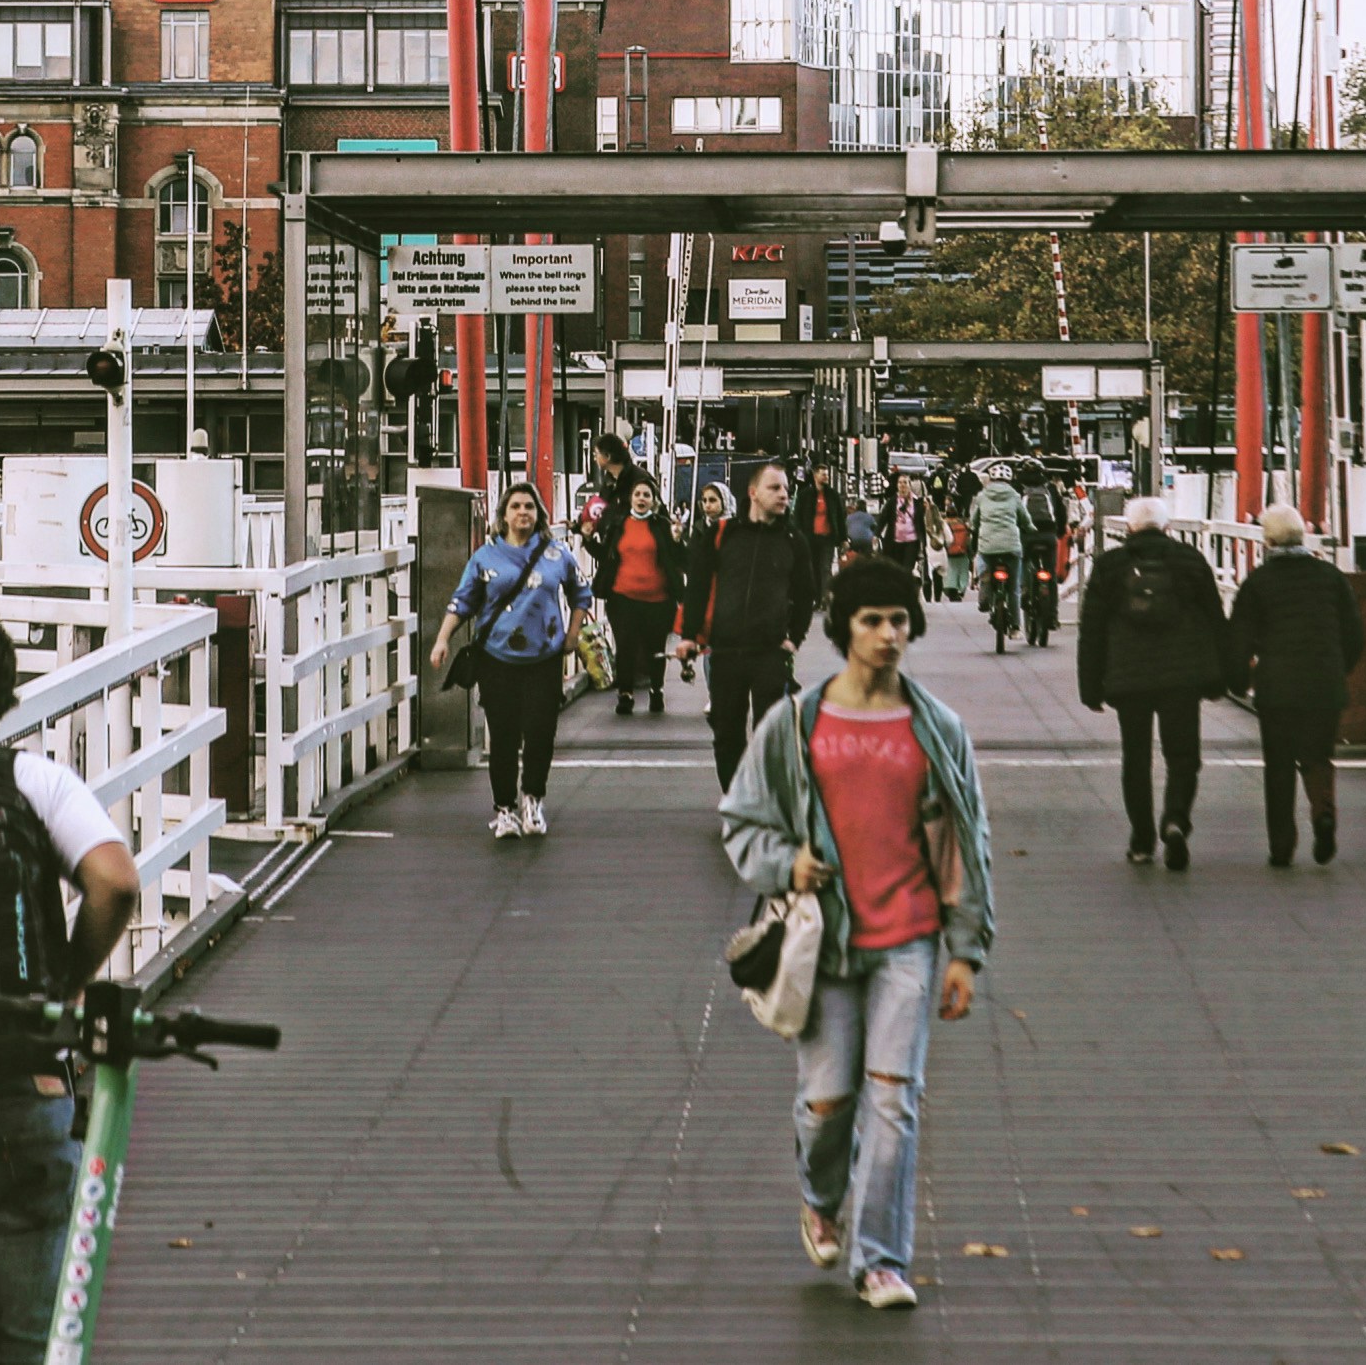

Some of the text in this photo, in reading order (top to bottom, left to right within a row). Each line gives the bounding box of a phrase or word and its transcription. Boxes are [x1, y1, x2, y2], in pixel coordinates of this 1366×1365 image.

[732, 244, 785, 262] KFC
[412, 250, 465, 267] Achtung
[512, 253, 573, 266] Important
[392, 270, 485, 282] Bei Ertönen des Signals
[499, 271, 586, 281] When the bell rings
[397, 284, 480, 294] bitte an die Haltelinie
[505, 284, 581, 294] please step back
[412, 297, 465, 307] zurücktreten
[510, 298, 576, 306] behind the line
[732, 296, 783, 305] MERIDIAN
